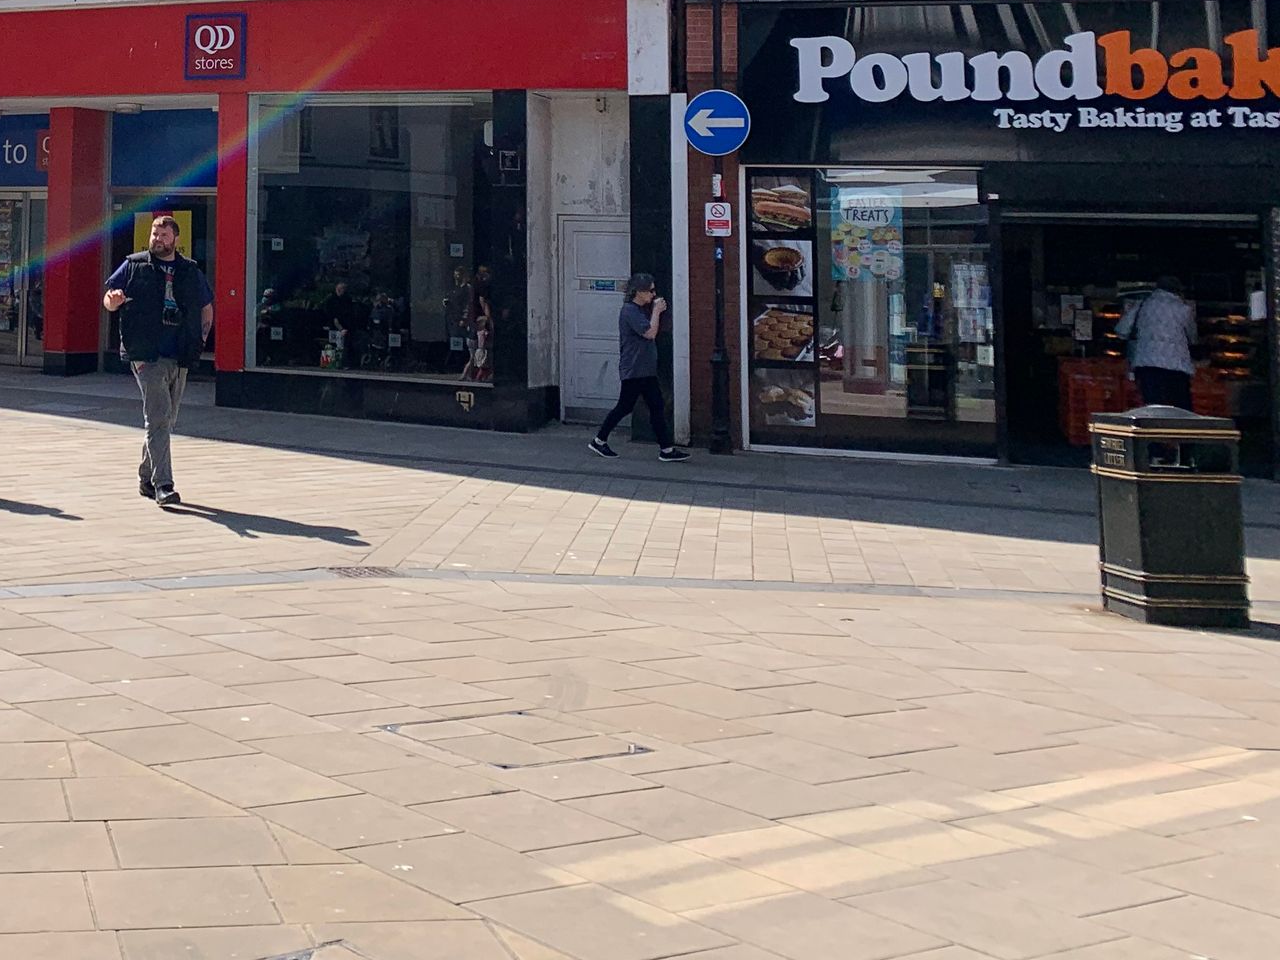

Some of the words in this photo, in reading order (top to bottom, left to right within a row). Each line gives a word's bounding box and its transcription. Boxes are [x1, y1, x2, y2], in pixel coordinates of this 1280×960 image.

[194, 25, 235, 55] QD
[194, 56, 234, 70] stores
[993, 108, 1072, 133] Tasty
[1077, 106, 1184, 133] Baking
[1190, 108, 1222, 128] at
[1227, 106, 1280, 128] Tas
[2, 139, 28, 164] to
[843, 208, 889, 223] TREATS
